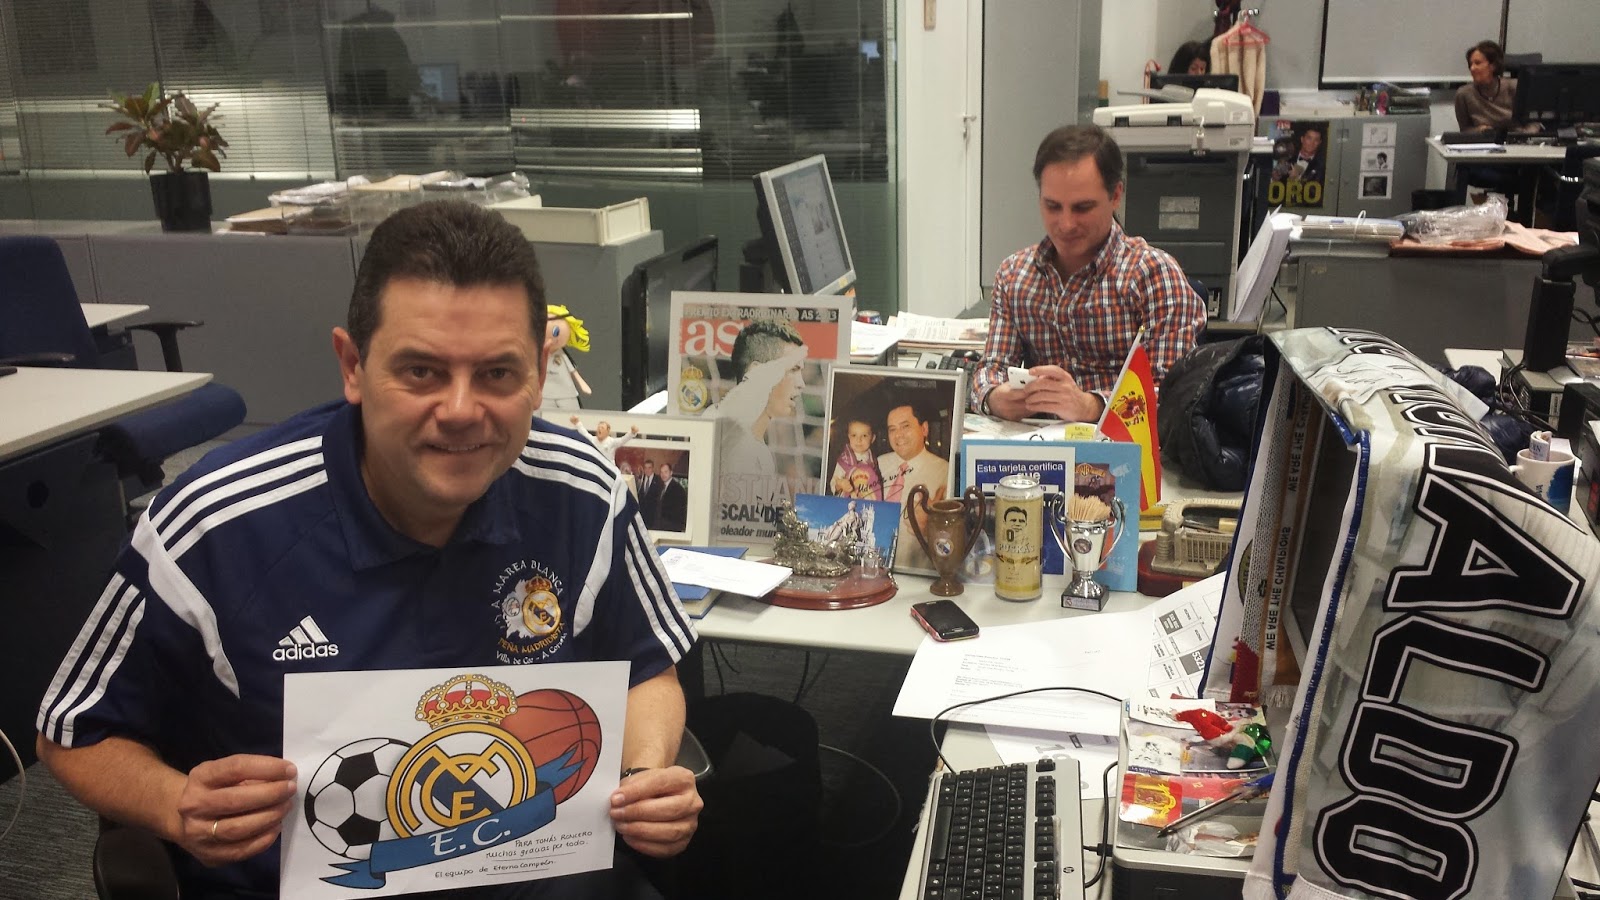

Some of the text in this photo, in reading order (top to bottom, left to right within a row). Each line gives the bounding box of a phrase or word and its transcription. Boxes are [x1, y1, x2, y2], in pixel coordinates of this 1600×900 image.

[1268, 179, 1322, 204] ORO
[722, 307, 799, 320] EXTRAORDINAR
[801, 310, 814, 320] AS
[815, 310, 837, 321] 213
[685, 320, 744, 357] as
[977, 462, 1063, 473] Esta tarjeta certifica
[720, 524, 754, 537] oleador
[493, 560, 527, 594] MAREA
[530, 560, 564, 597] BLANCA
[1312, 384, 1586, 900] ALDO
[272, 642, 339, 661] adidas
[515, 839, 533, 848] PARA
[560, 831, 593, 841] RONCERO
[520, 845, 550, 857] gracias
[552, 843, 563, 852] por
[434, 871, 443, 879] El
[444, 869, 474, 879] equipo
[479, 865, 489, 873] de
